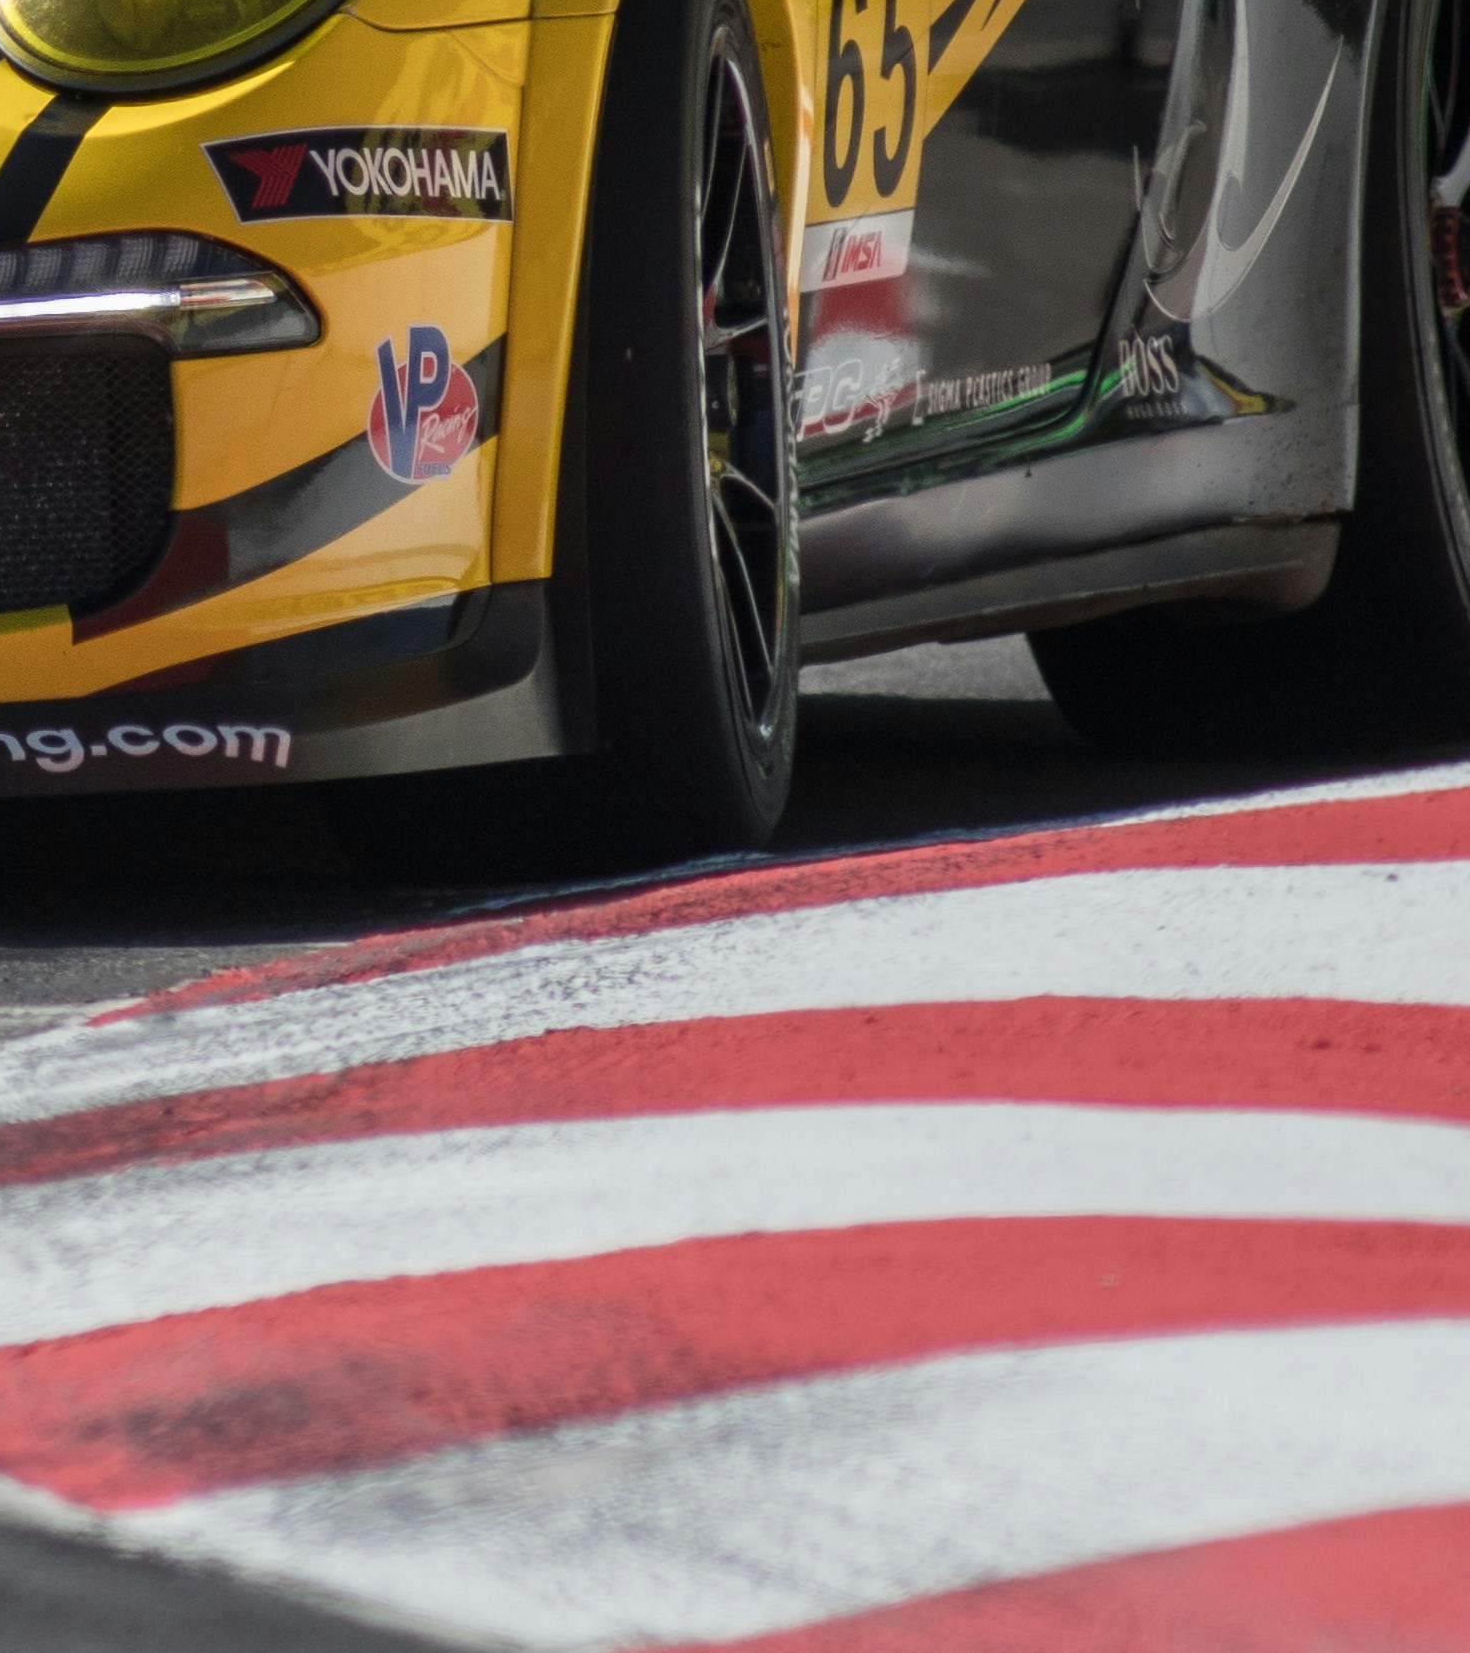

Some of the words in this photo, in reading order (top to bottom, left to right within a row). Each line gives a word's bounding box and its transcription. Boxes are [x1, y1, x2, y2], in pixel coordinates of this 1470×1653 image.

[308, 146, 500, 200] YOKOHAMA
[377, 325, 450, 481] VP
[794, 359, 861, 440] PC
